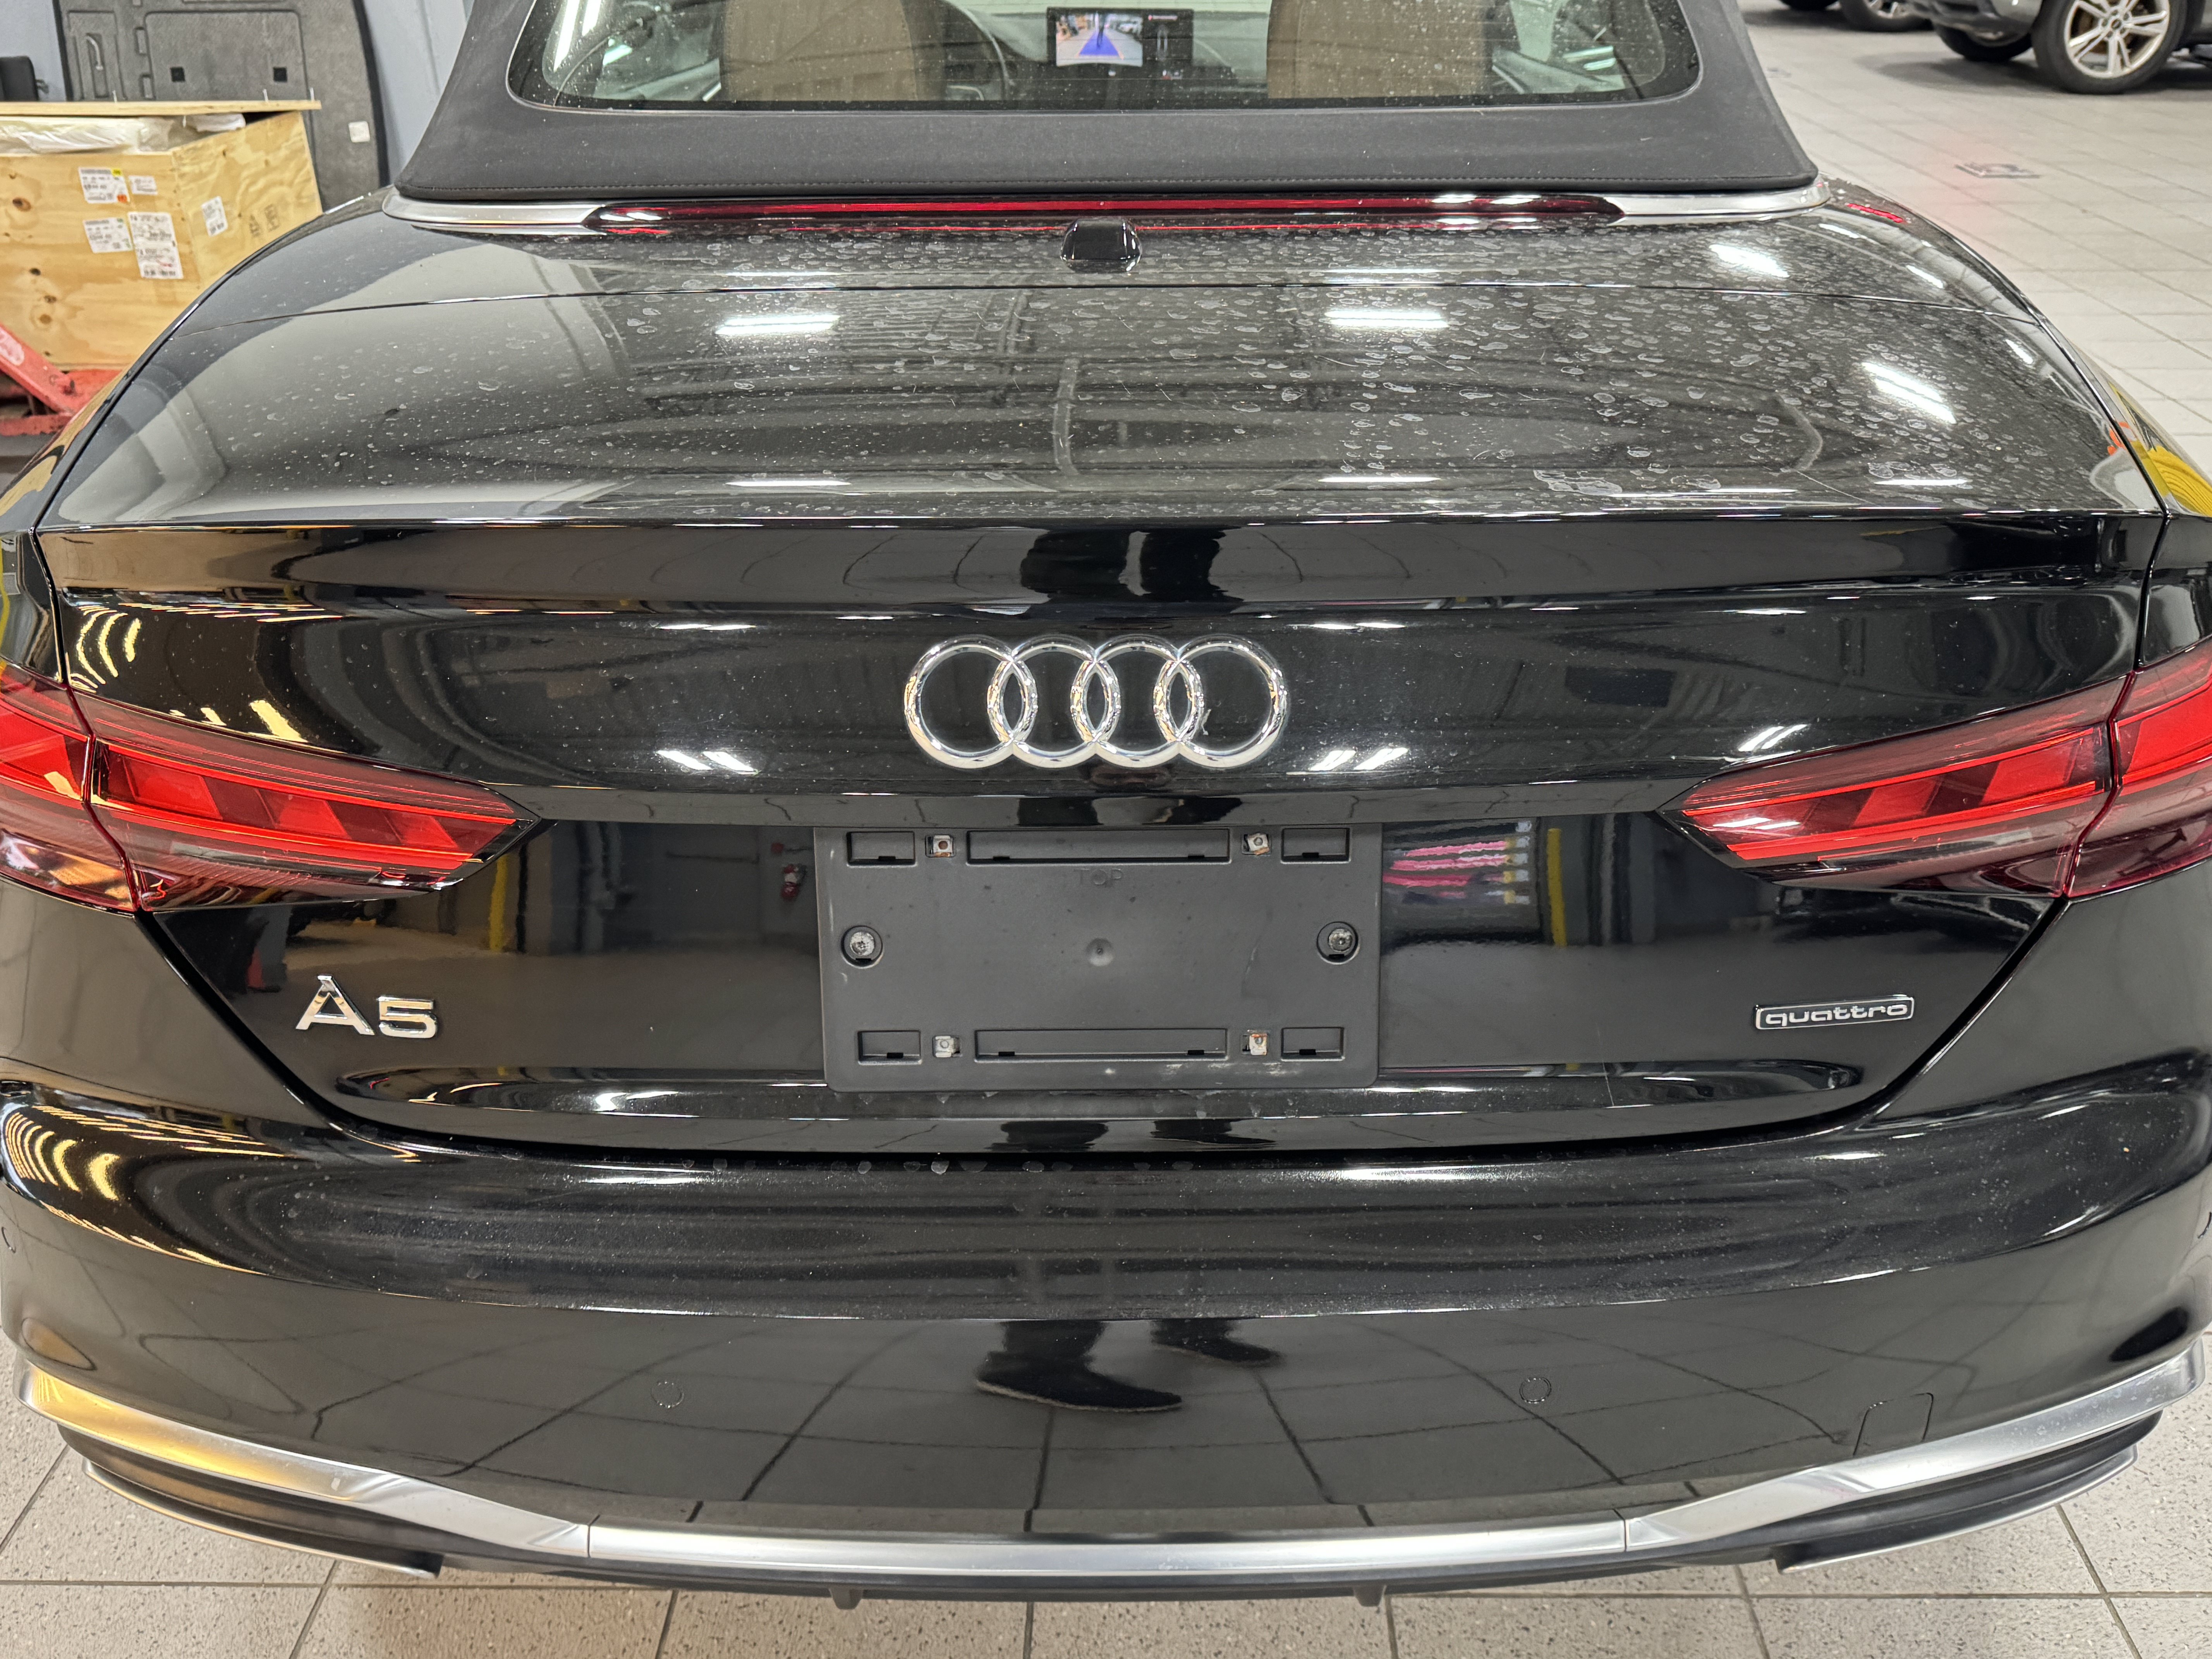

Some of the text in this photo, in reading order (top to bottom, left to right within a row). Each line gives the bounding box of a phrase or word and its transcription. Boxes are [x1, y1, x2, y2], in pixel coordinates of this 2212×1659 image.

[1073, 868, 1123, 886] TOP
[295, 974, 438, 1039] A5
[1766, 1004, 1908, 1027] quattro
